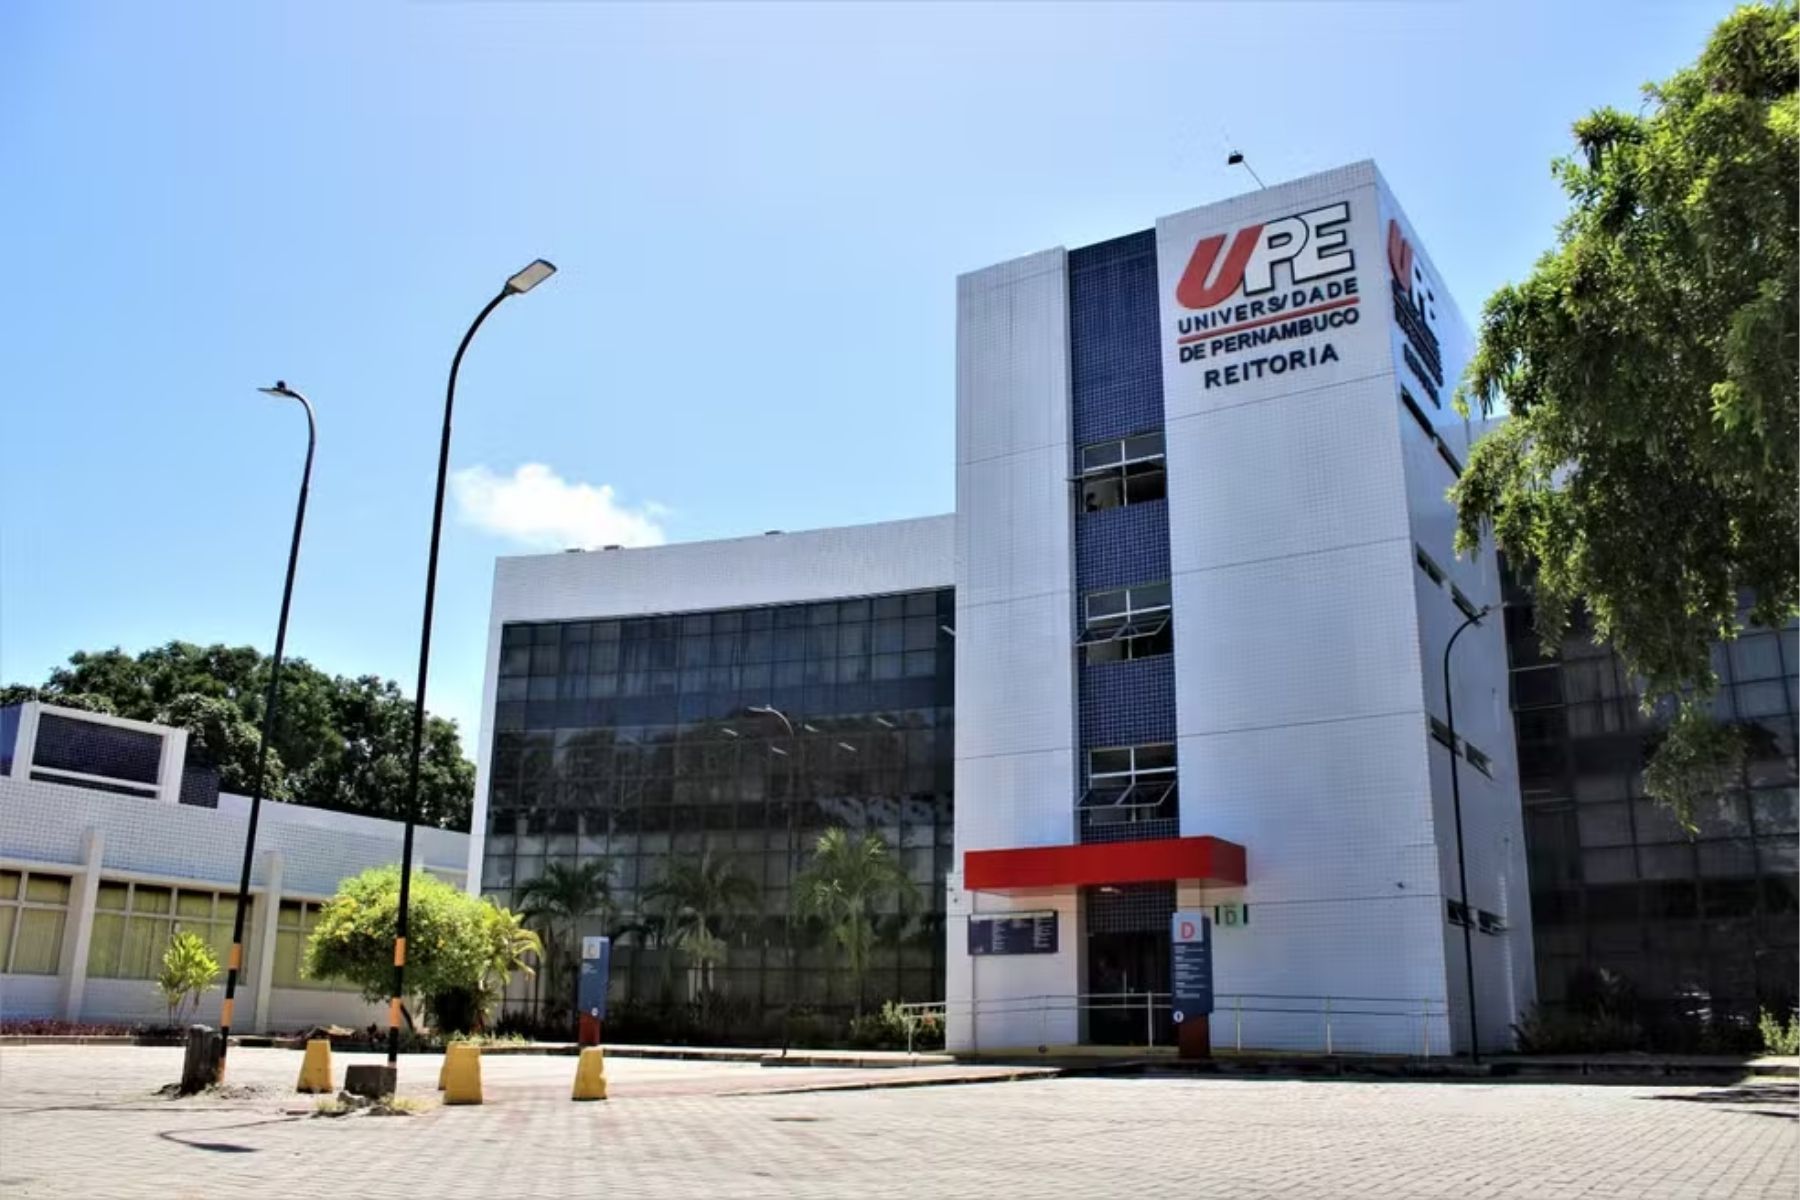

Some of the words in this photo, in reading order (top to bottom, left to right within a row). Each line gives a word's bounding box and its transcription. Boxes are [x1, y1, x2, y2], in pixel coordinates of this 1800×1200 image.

[1176, 201, 1355, 310] UPE
[1178, 277, 1359, 334] UNIVERSIDADE
[1179, 342, 1206, 364] DE
[1211, 307, 1360, 357] PERNAMBUCO
[1204, 343, 1339, 389] REITORIA
[1181, 922, 1194, 939] D
